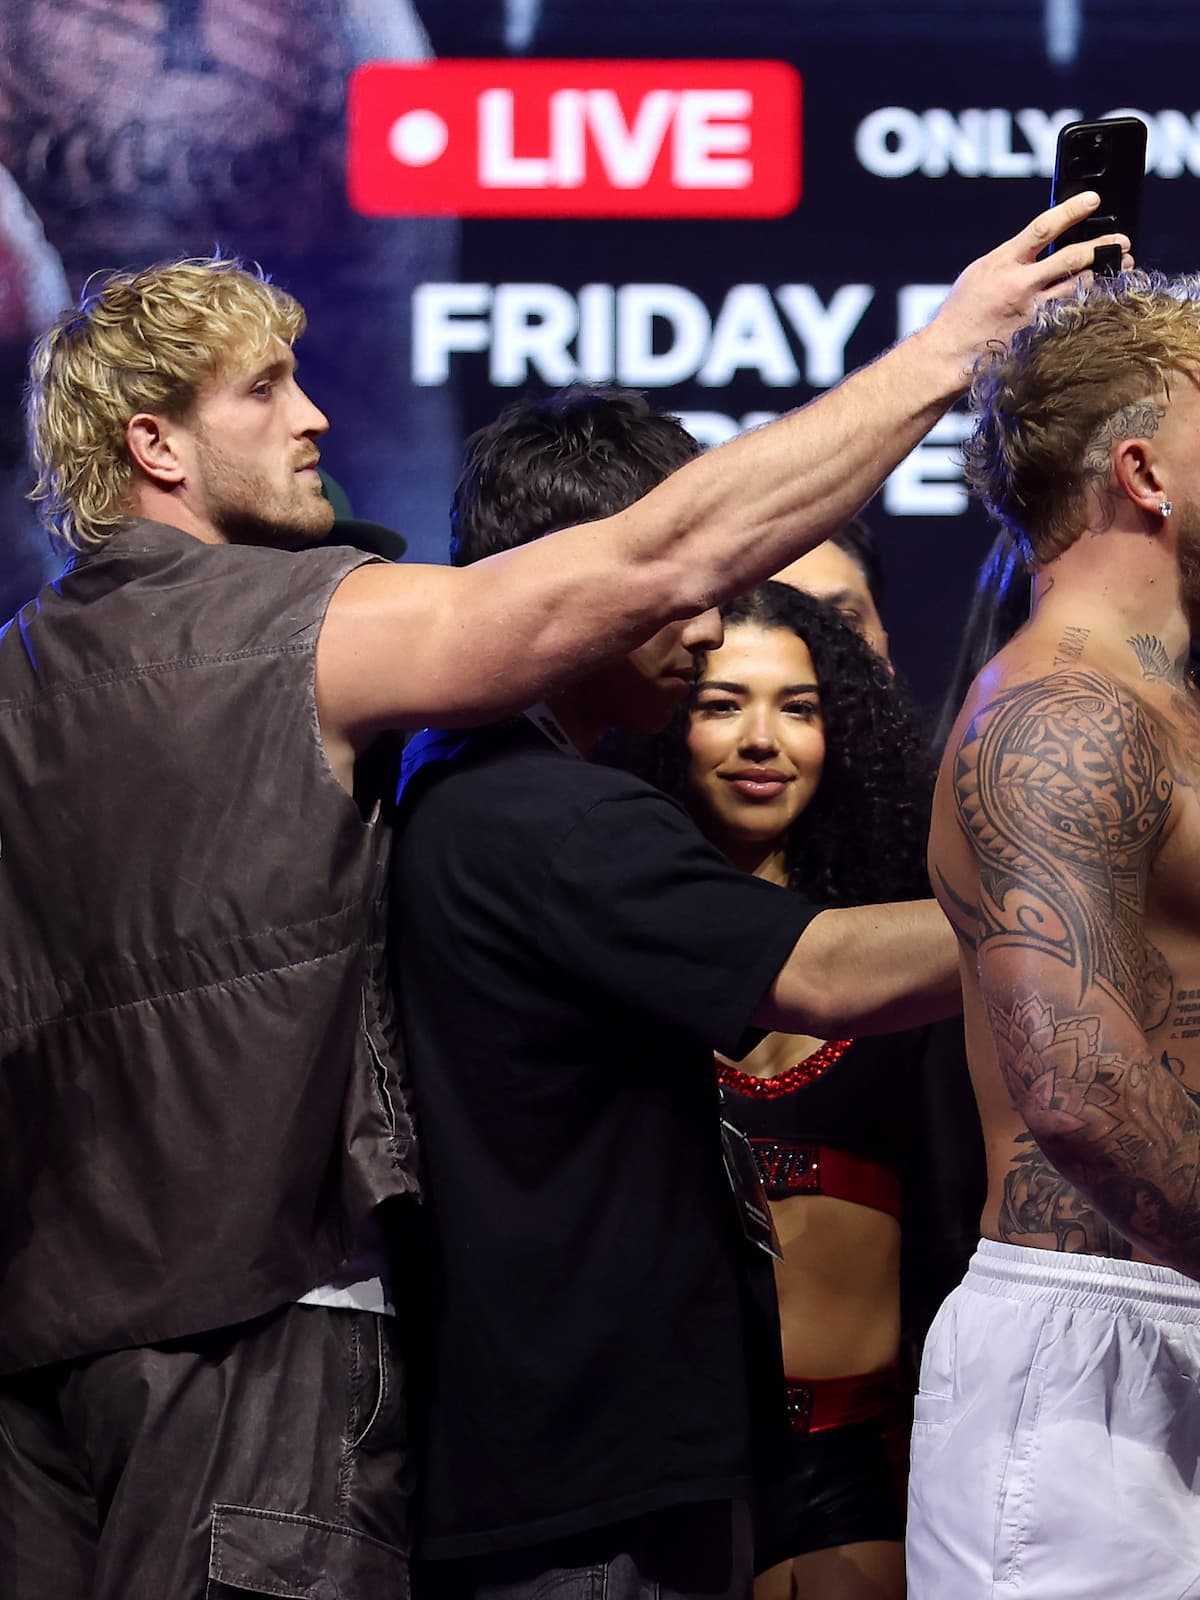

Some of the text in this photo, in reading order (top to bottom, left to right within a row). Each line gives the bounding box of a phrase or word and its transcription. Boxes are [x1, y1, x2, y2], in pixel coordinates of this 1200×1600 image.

[478, 89, 753, 190] LIVE
[854, 106, 1081, 178] ONLY
[411, 283, 874, 387] FRIDAY
